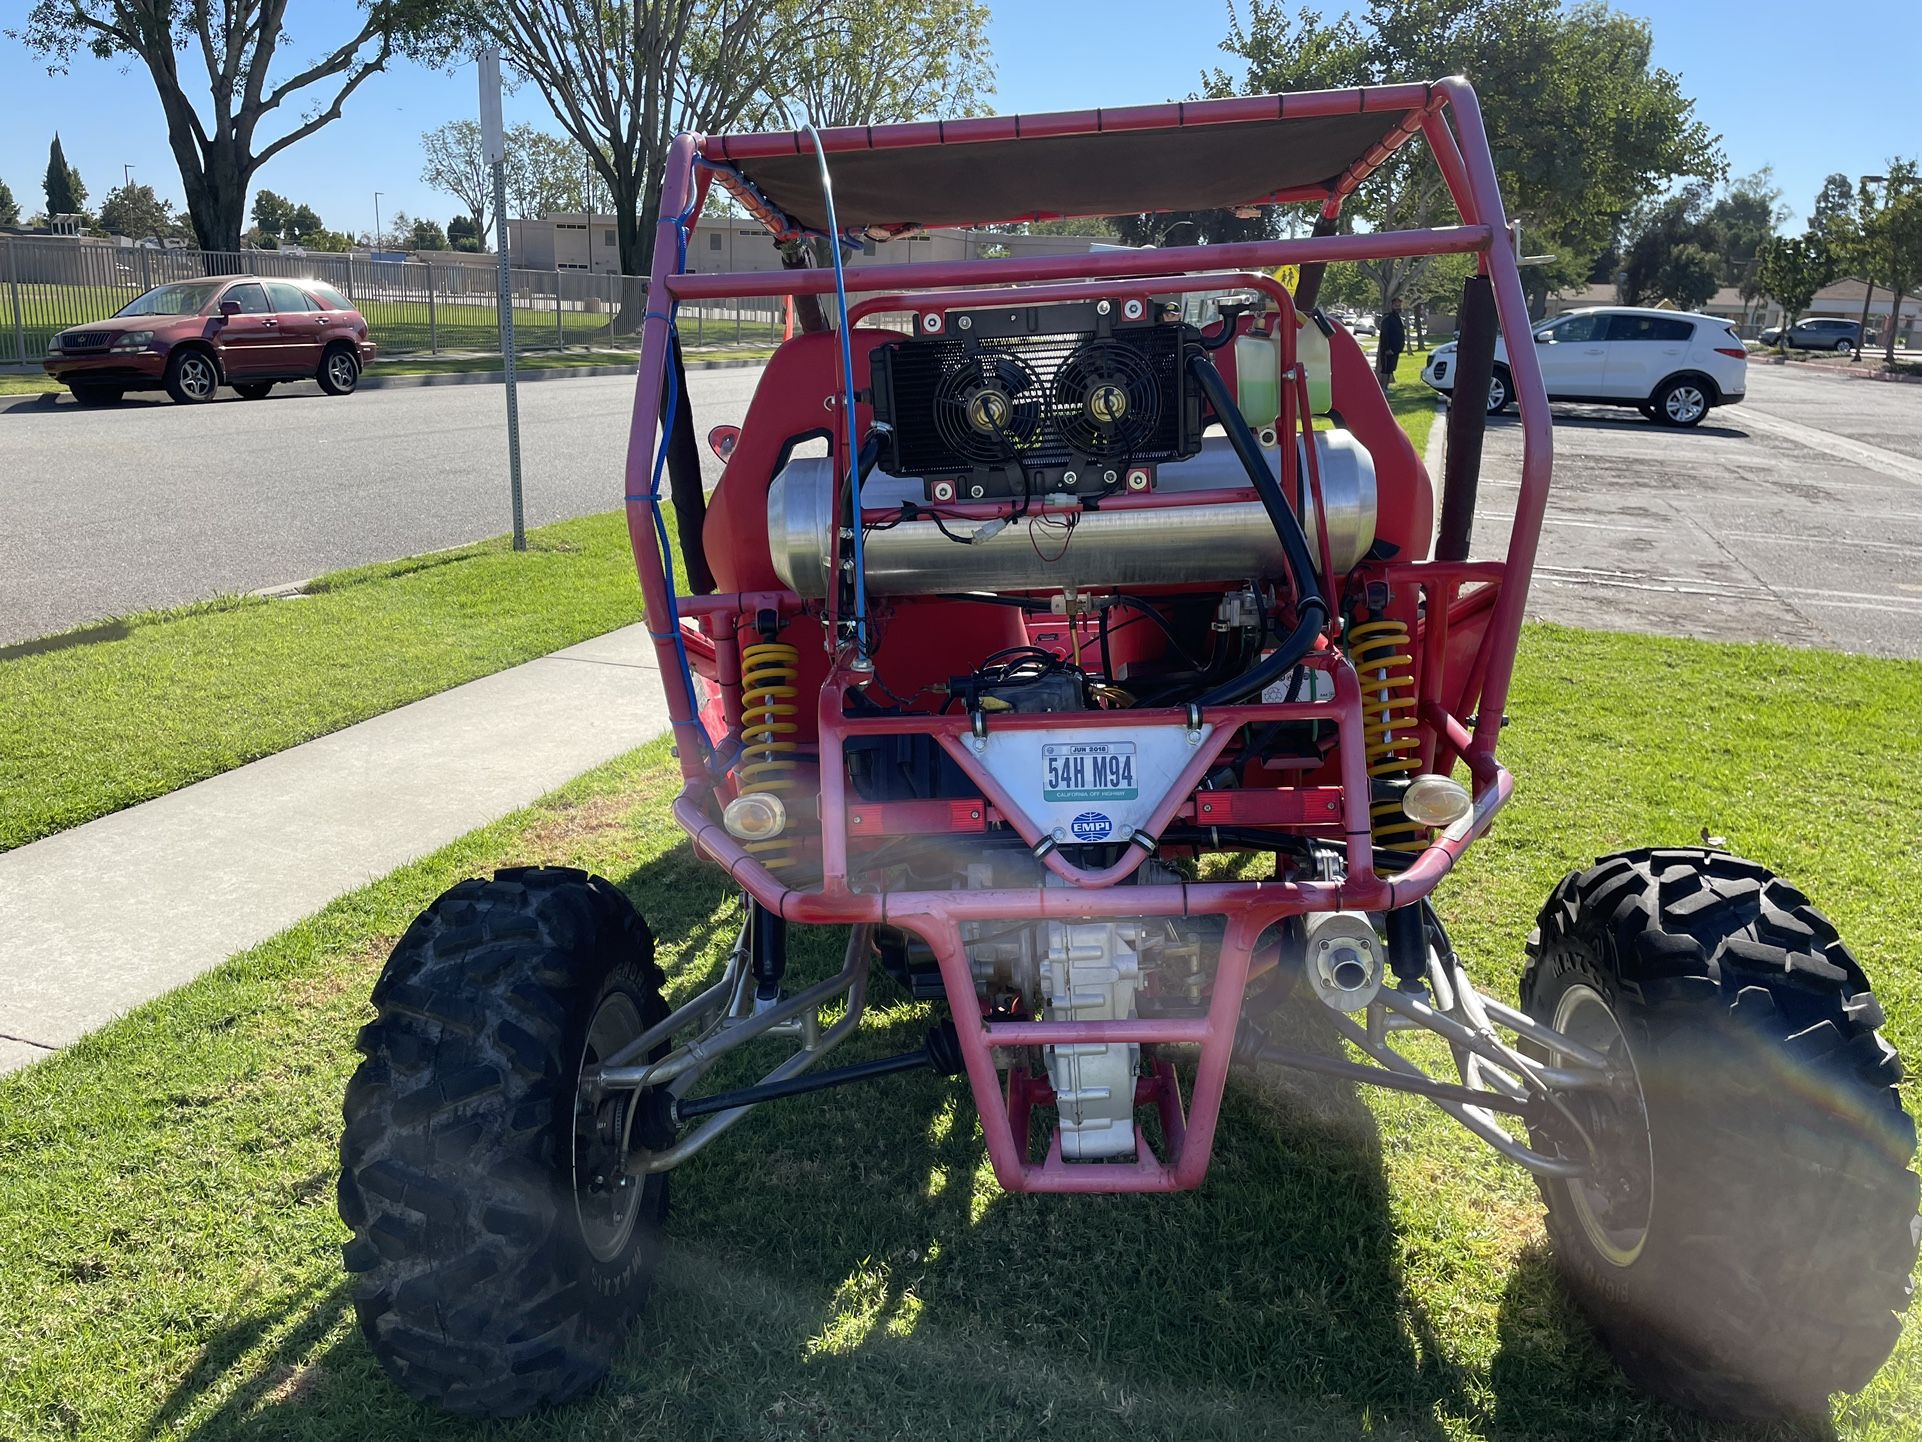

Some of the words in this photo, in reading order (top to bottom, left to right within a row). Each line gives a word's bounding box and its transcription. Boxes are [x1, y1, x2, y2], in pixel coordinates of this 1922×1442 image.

[1048, 756, 1085, 789] 54H
[1092, 755, 1133, 788] M94
[1073, 822, 1110, 832] EMPI
